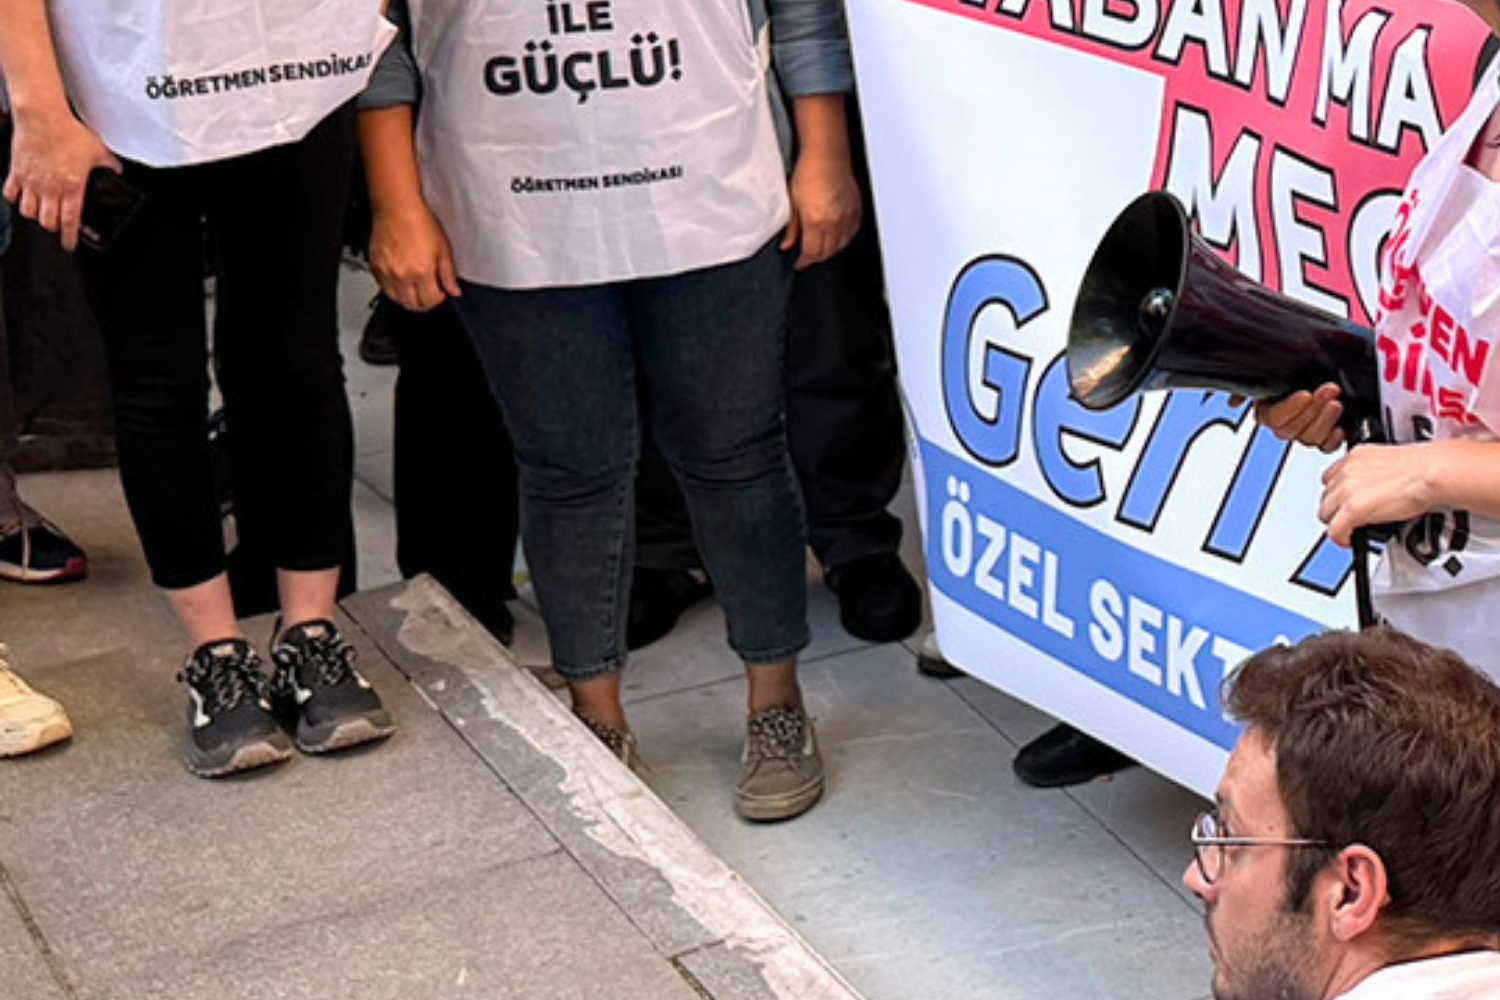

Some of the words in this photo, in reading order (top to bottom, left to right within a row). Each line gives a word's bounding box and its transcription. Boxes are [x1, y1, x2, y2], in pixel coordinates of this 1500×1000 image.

[145, 67, 266, 100] ÖĞRETMEN
[483, 31, 682, 104] GÜÇLÜ!
[510, 175, 599, 194] ÖĞRETMEN
[602, 165, 683, 189] SENDİKASI
[940, 475, 1075, 641] ÖZEL
[1089, 577, 1252, 718] SEKT
